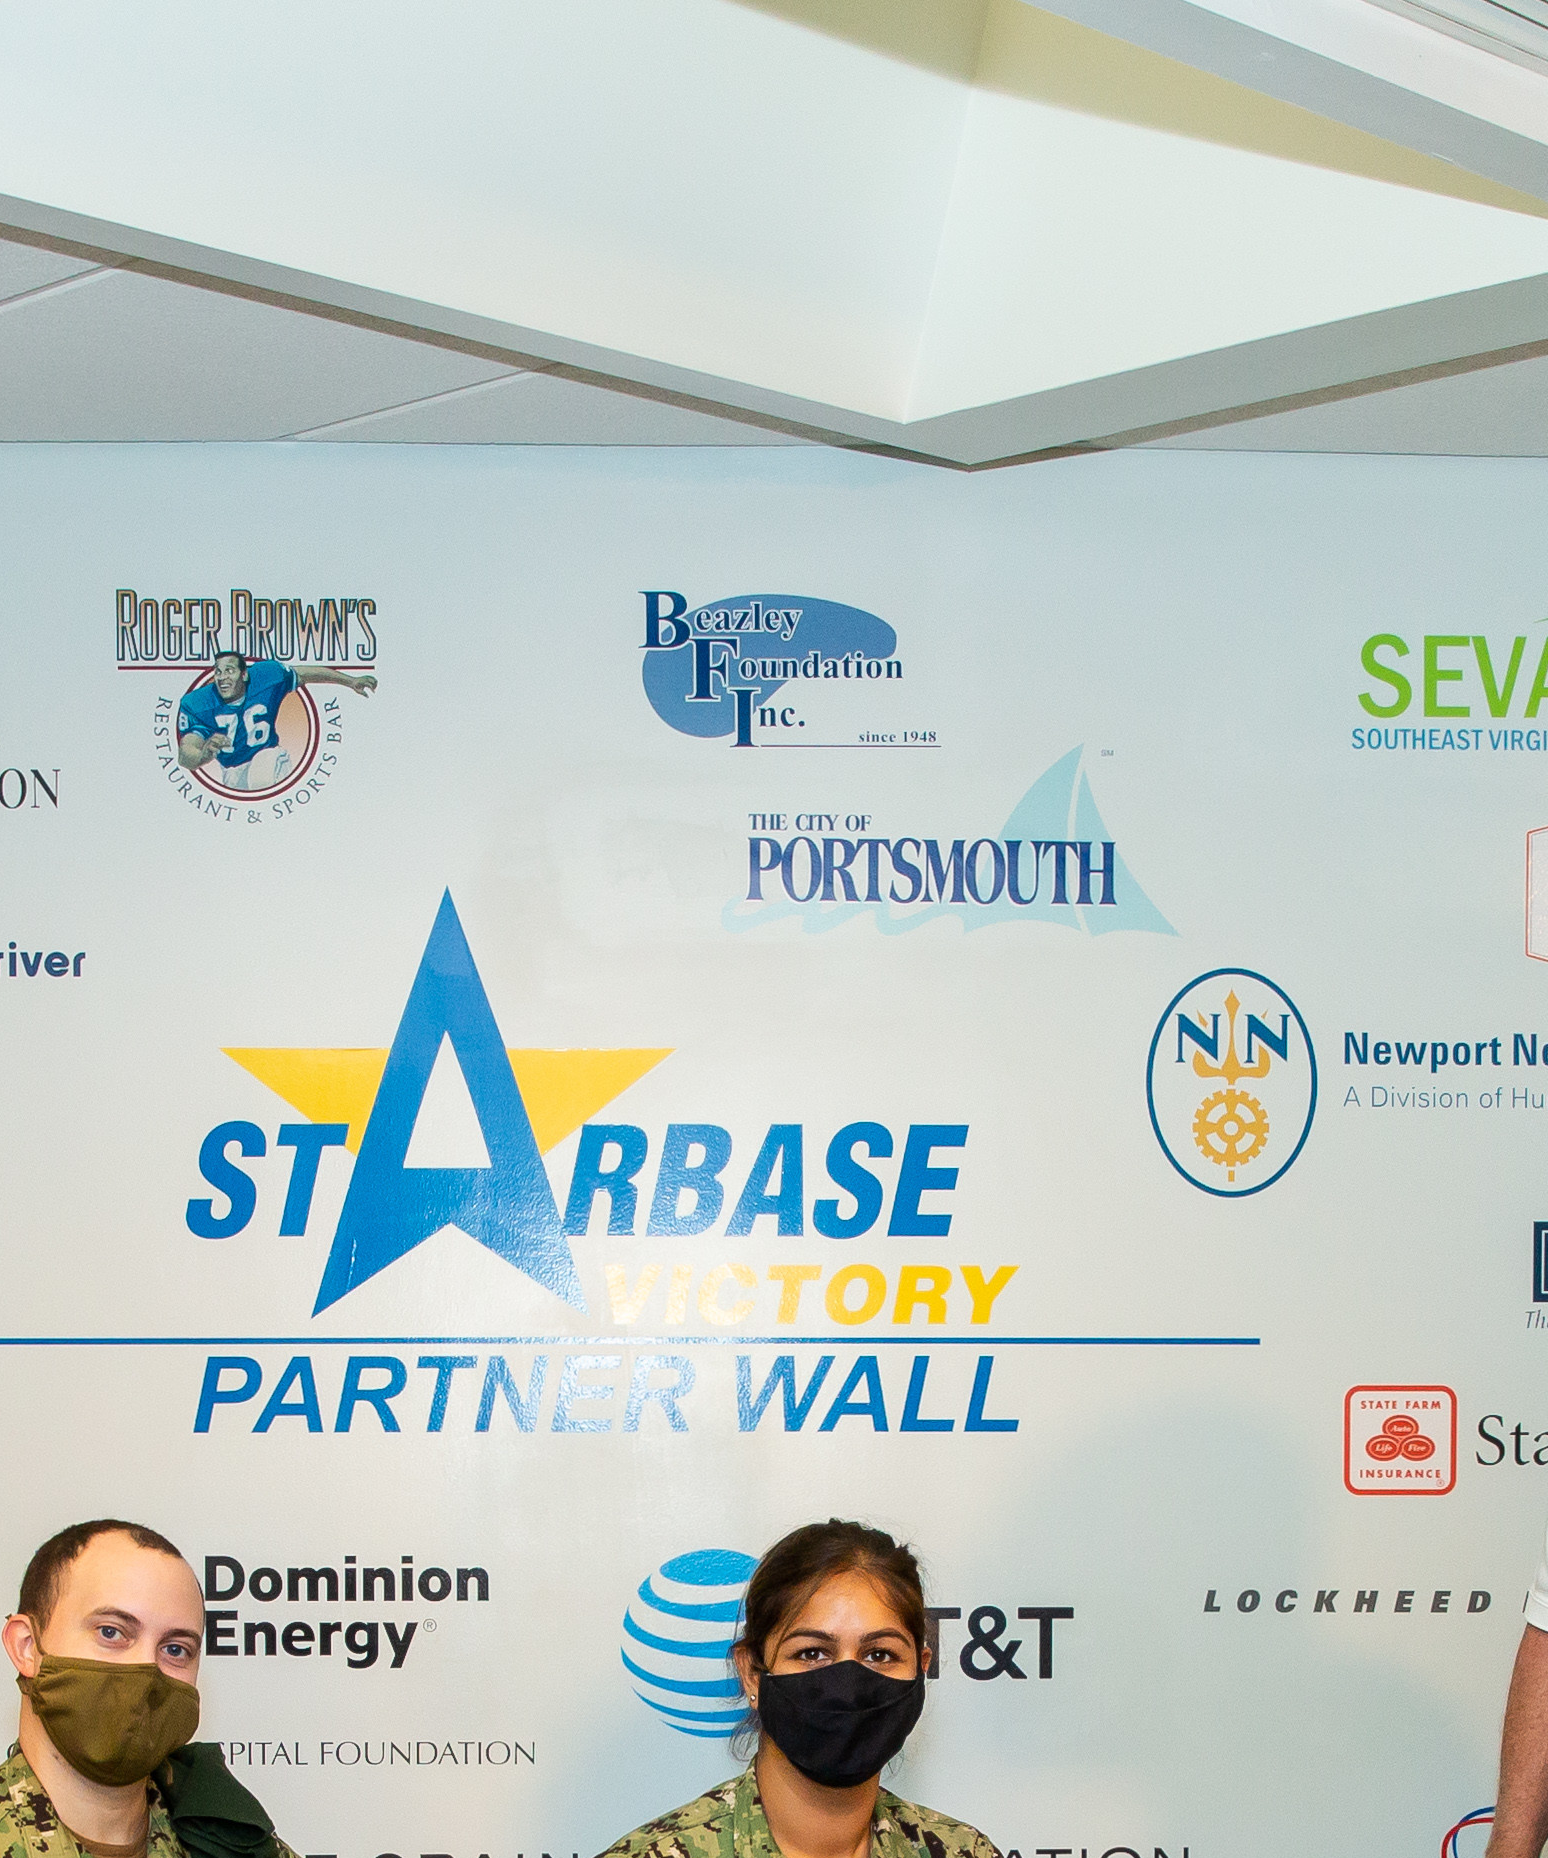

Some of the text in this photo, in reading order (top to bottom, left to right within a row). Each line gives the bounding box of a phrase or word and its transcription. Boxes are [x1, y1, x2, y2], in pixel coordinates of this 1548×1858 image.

[116, 589, 377, 661] ROGER BROWN'S
[638, 591, 803, 649] Beazley
[685, 638, 903, 701] Foundation
[729, 688, 806, 747] Inc.
[858, 730, 938, 743] since 1948
[1351, 728, 1483, 751] SOUTHEAST
[154, 696, 344, 823] RESTAURANT & SPORTS BAR
[748, 813, 872, 832] THE CITY OF
[746, 836, 1118, 907] PORTSMOUTH
[1343, 1032, 1502, 1072] Newport
[1343, 1086, 1361, 1109] A
[1370, 1086, 1470, 1109] Division
[1479, 1087, 1503, 1109] of
[608, 1265, 1021, 1326] VICTORY
[193, 1356, 1021, 1433] PARTNER WALL
[1361, 1400, 1441, 1409] STATE FARM
[1359, 1469, 1441, 1478] INSURANCE
[205, 1555, 490, 1602] Dominion
[1203, 1589, 1493, 1613] LOCKHEED
[205, 1610, 419, 1669] Energy
[924, 1605, 1074, 1680] T&T
[217, 1741, 536, 1765] SPITAL FOUNDATION
